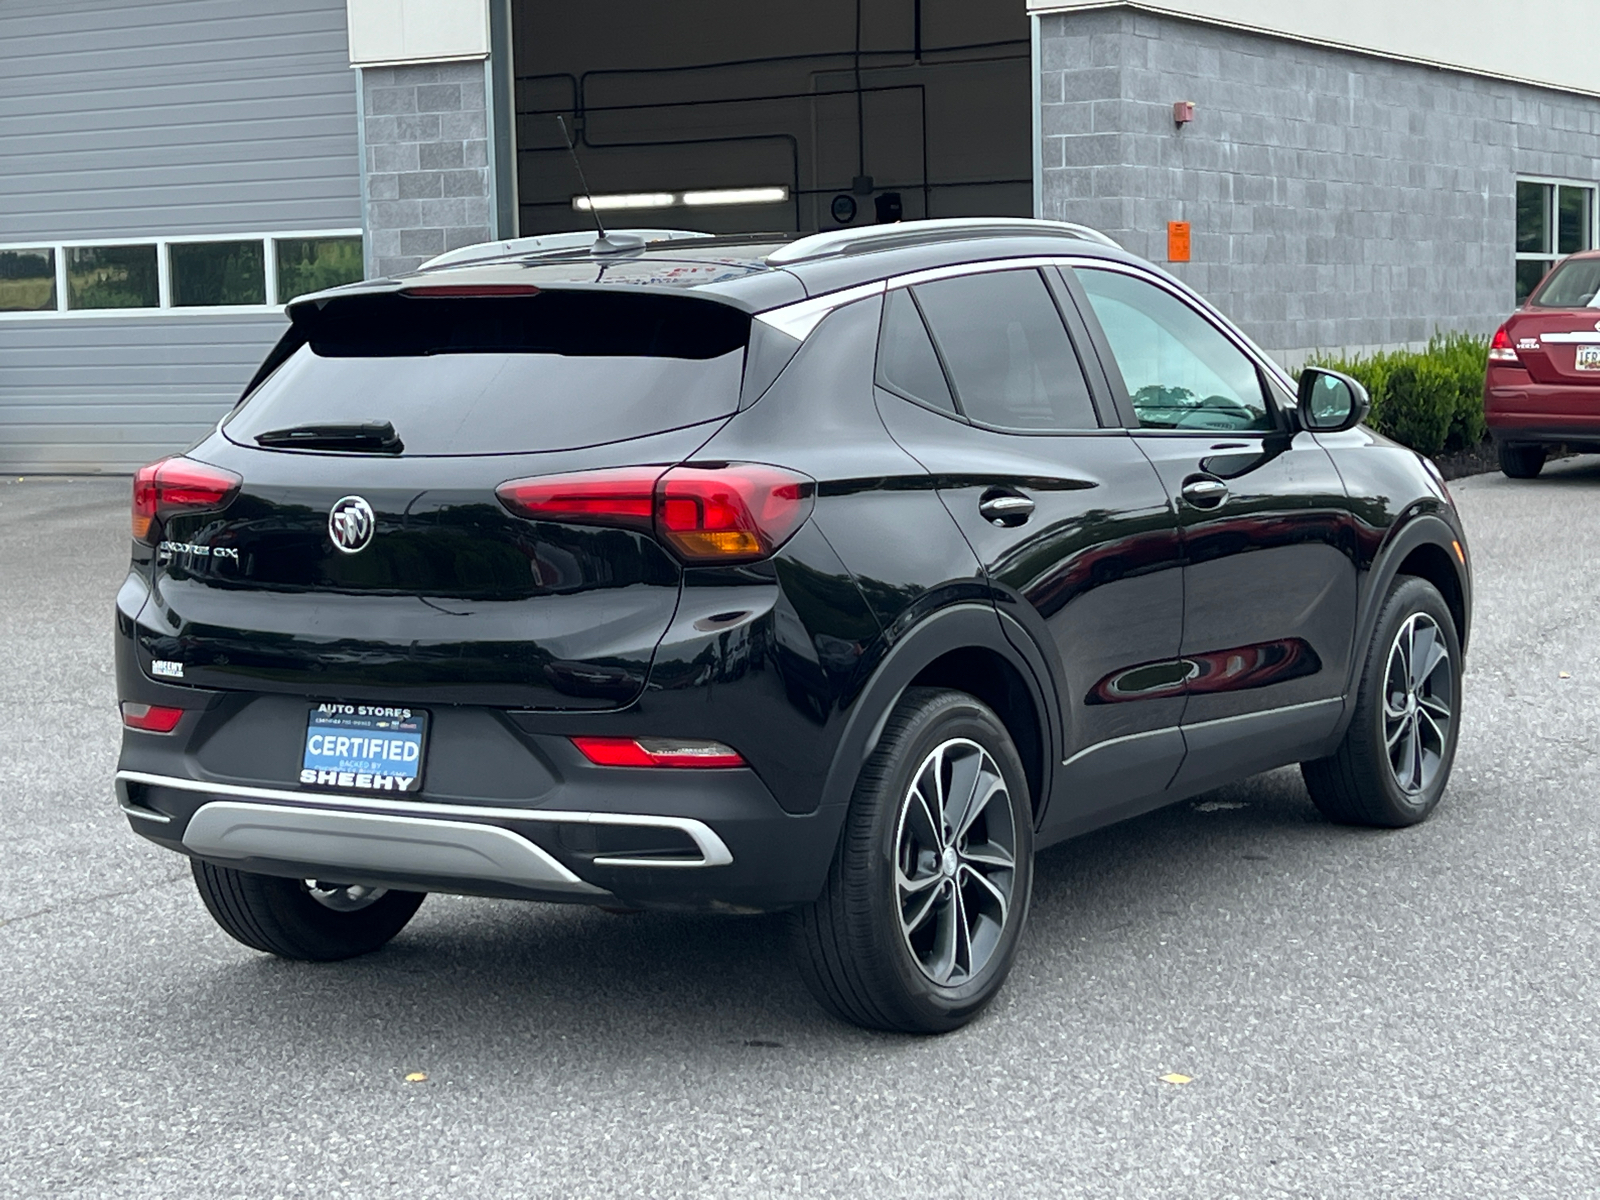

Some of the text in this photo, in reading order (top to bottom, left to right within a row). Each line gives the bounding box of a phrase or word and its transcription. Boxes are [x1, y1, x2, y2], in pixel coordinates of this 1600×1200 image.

[213, 547, 238, 558] GX
[318, 703, 411, 718] AUTO STORES
[308, 734, 419, 762] CERTIFIED
[340, 760, 370, 768] BACKED
[300, 769, 414, 791] SHEEHY
